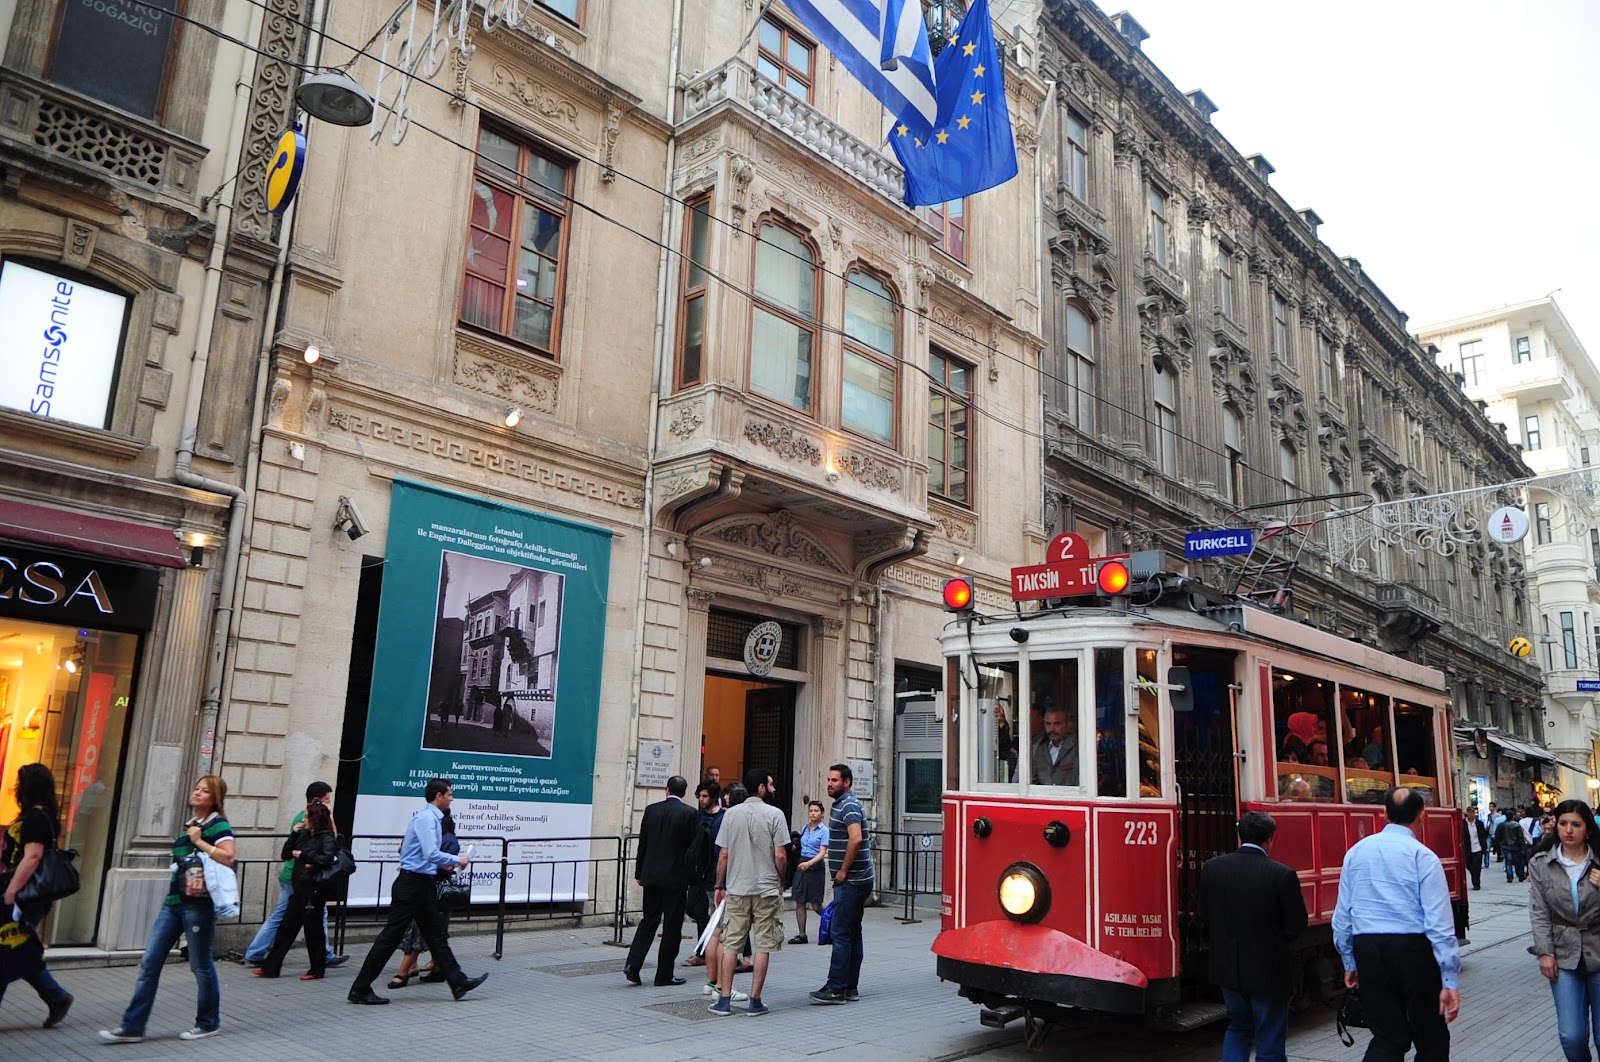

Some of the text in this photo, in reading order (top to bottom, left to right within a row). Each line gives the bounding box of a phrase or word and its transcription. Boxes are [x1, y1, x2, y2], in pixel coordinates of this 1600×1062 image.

[417, 528, 428, 537] ile
[428, 530, 456, 543] Eugène
[506, 547, 550, 563] objektifinden
[488, 534, 523, 548] fotoğrafçı
[523, 542, 547, 554] Achille
[547, 548, 578, 561] Samandji
[1060, 536, 1074, 559] 2
[1188, 536, 1248, 551] TURKCELL
[1016, 568, 1059, 592] TAKSİM
[1080, 563, 1097, 585] TÜ
[452, 762, 522, 775] Κωνσταντινούπολις
[439, 771, 459, 780] μέσα
[460, 772, 475, 780] από
[407, 780, 428, 789] Αχιλλ
[468, 803, 499, 811] Istanbul
[459, 812, 474, 820] lens
[485, 813, 514, 821] Achilles
[515, 814, 548, 823] Samandji
[458, 823, 521, 832] Eugene Dalleggio
[1124, 820, 1158, 845] 223
[1141, 914, 1162, 924] YASAK
[1104, 925, 1115, 936] VE
